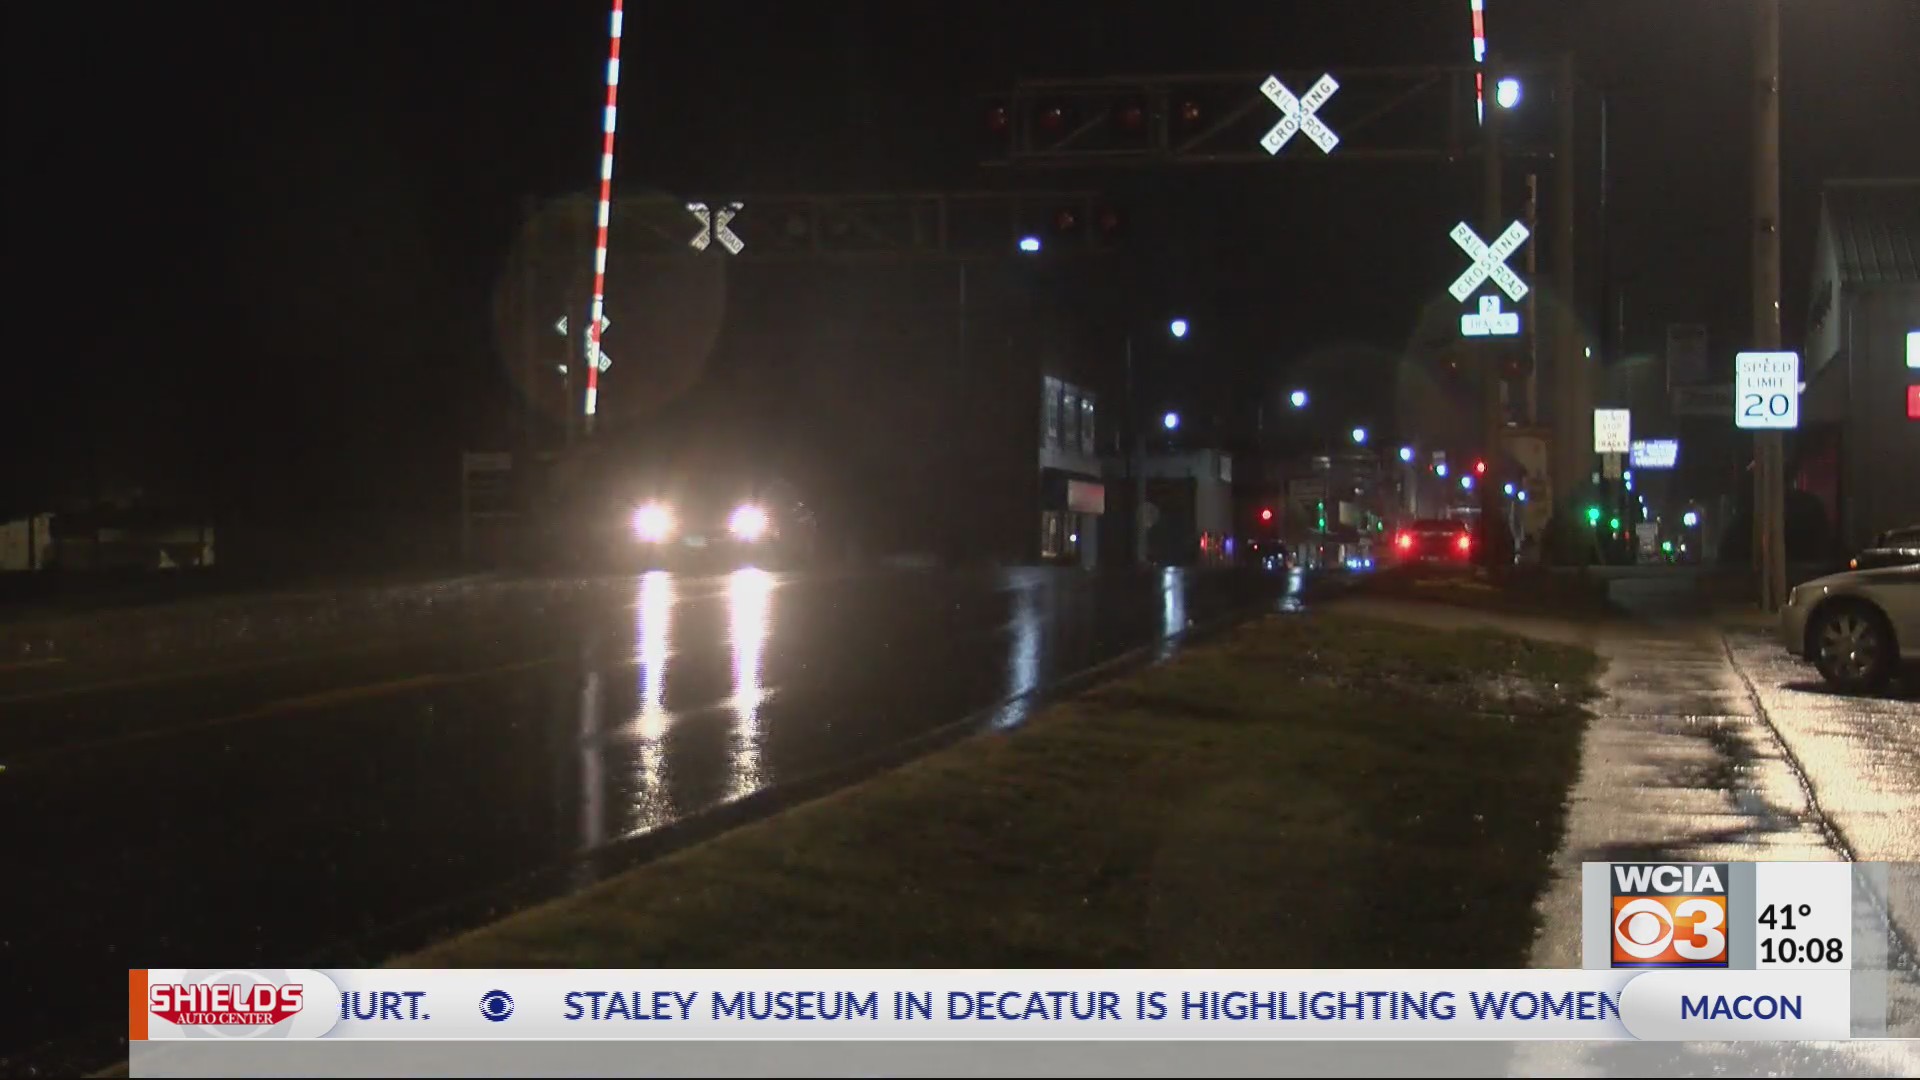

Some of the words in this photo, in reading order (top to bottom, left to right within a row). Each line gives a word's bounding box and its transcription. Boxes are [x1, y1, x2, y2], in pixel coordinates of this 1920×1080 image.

[1265, 80, 1292, 111] RAIL
[1304, 118, 1335, 149] ROAD
[1268, 81, 1332, 148] CROSSING
[1456, 226, 1481, 258] RAIL
[1494, 264, 1523, 296] ROAD
[1456, 229, 1522, 294] CROSSING
[1470, 319, 1510, 330] TRAKS
[1743, 361, 1792, 373] SPEED
[1747, 377, 1785, 388] LIMIT
[1743, 393, 1790, 417] 20
